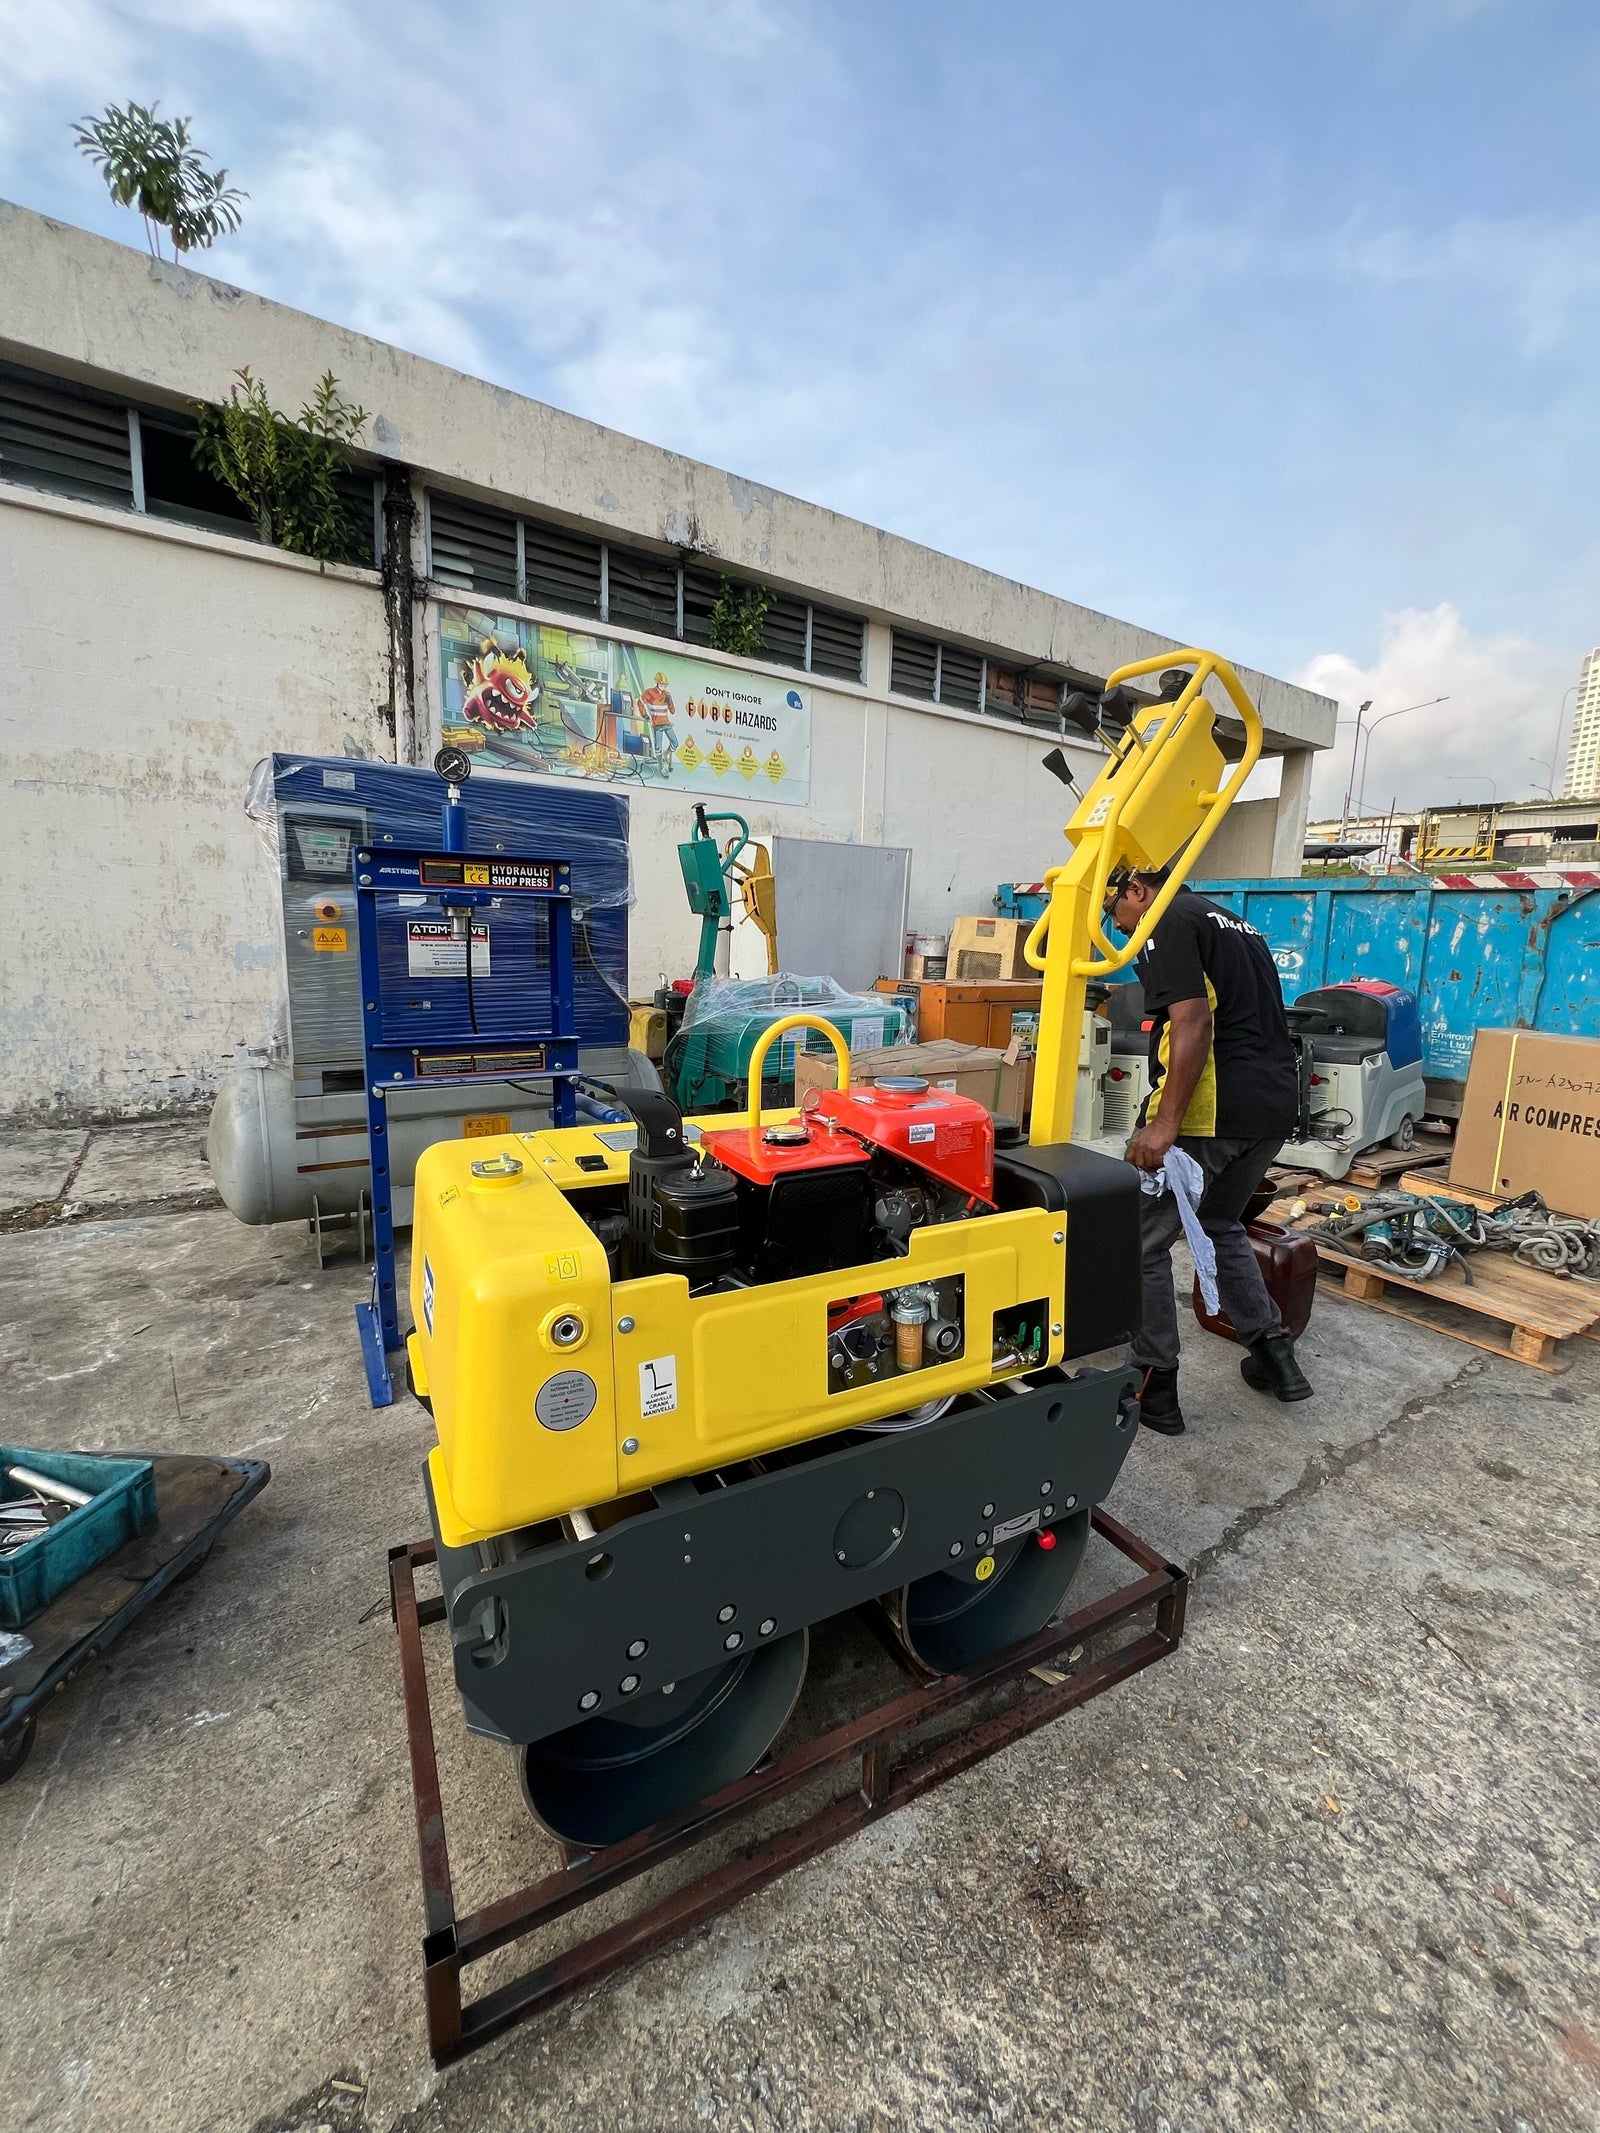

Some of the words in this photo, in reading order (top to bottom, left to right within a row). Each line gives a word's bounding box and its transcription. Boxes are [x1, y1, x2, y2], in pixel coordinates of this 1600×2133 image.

[705, 686, 730, 699] DON'T
[732, 692, 762, 705] IGNORE
[688, 702, 731, 724] FIRE
[735, 710, 777, 731] HAZARDS
[491, 865, 550, 877] HYDRAULIC
[492, 876, 518, 886] SHOP
[519, 877, 549, 887] PRESS
[411, 924, 486, 936] ATOM-VE
[1493, 1100, 1520, 1122] AR
[645, 1394, 673, 1405] MANIVELLE
[650, 1391, 668, 1399] CRANK
[643, 1403, 676, 1417] MANIVELLE
[648, 1400, 669, 1410] CRANK
